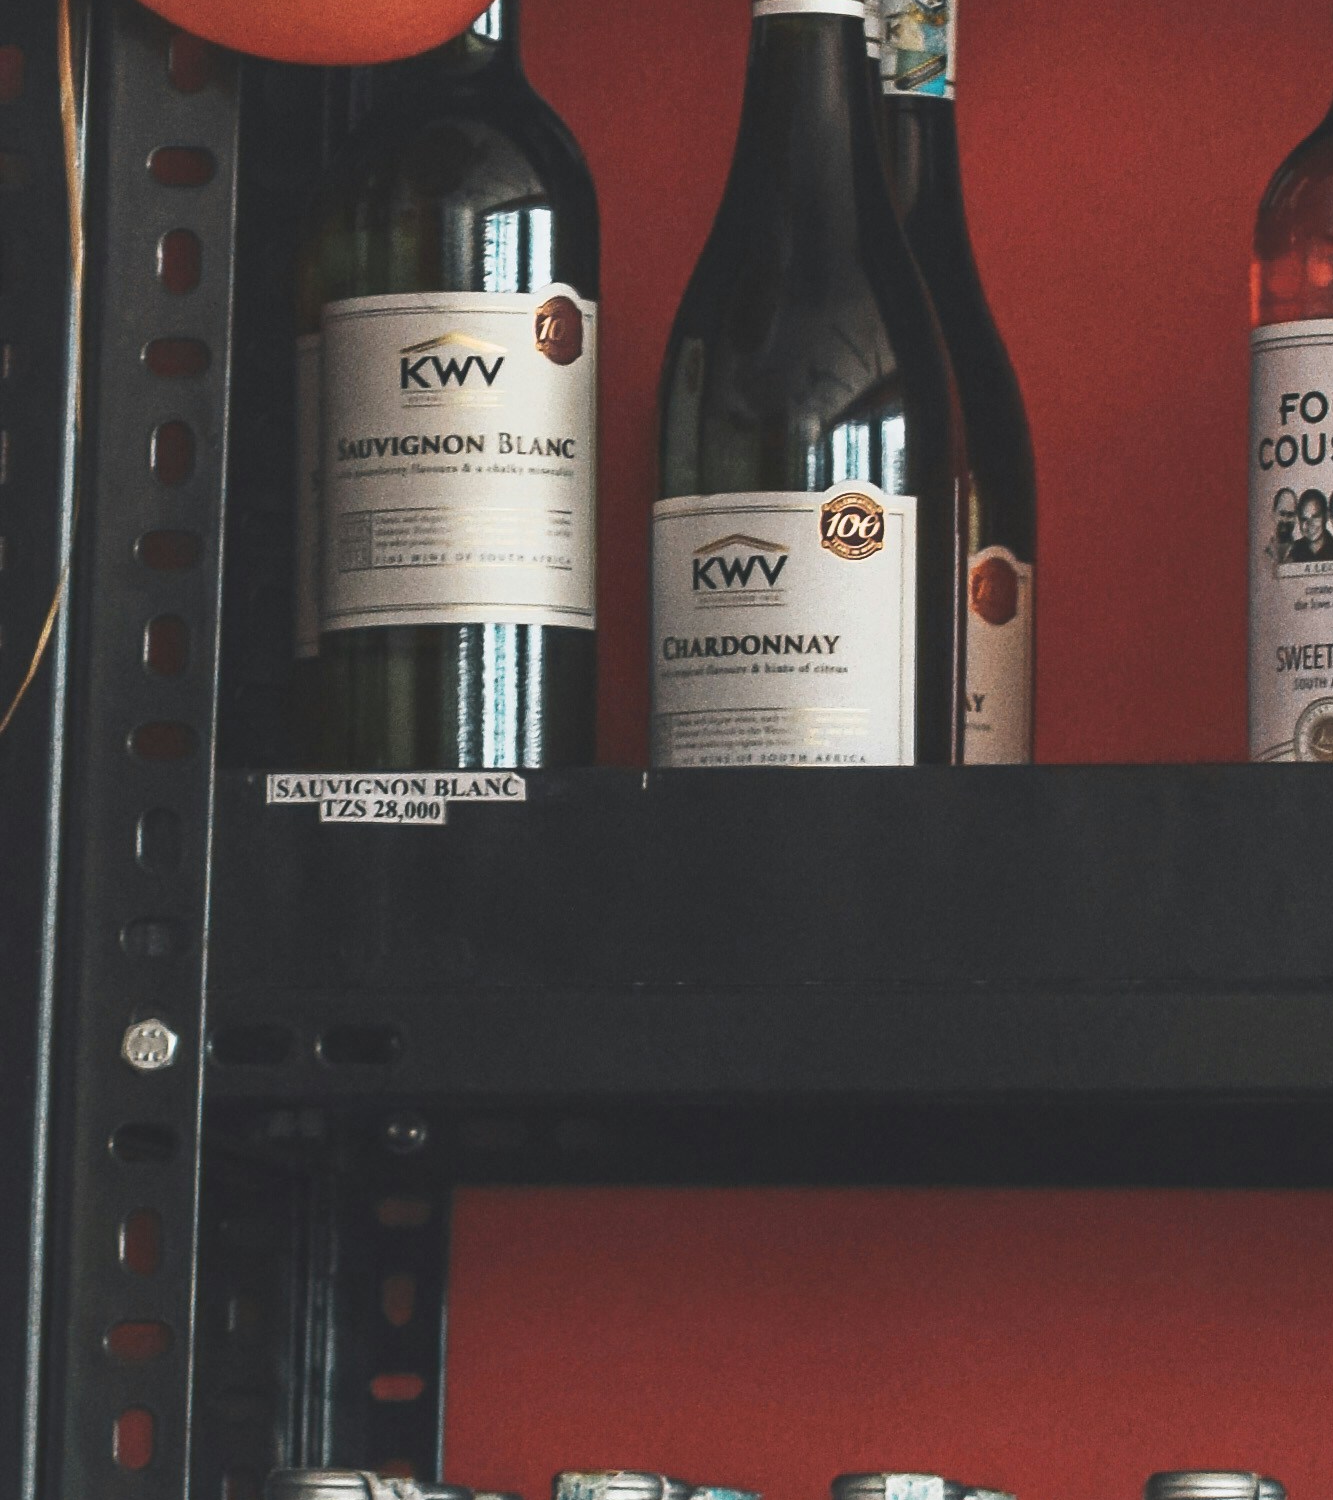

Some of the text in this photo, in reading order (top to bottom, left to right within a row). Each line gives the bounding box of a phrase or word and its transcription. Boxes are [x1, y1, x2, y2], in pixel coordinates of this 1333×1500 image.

[401, 356, 505, 389] KWV
[337, 432, 576, 461] SAUVIGNON BLANC
[827, 512, 880, 539] 100
[692, 555, 788, 590] KWV
[663, 635, 840, 660] CHARDONNAY
[276, 777, 519, 798] SAUVIGNON BLANC
[324, 800, 441, 822] TZS 28,000
